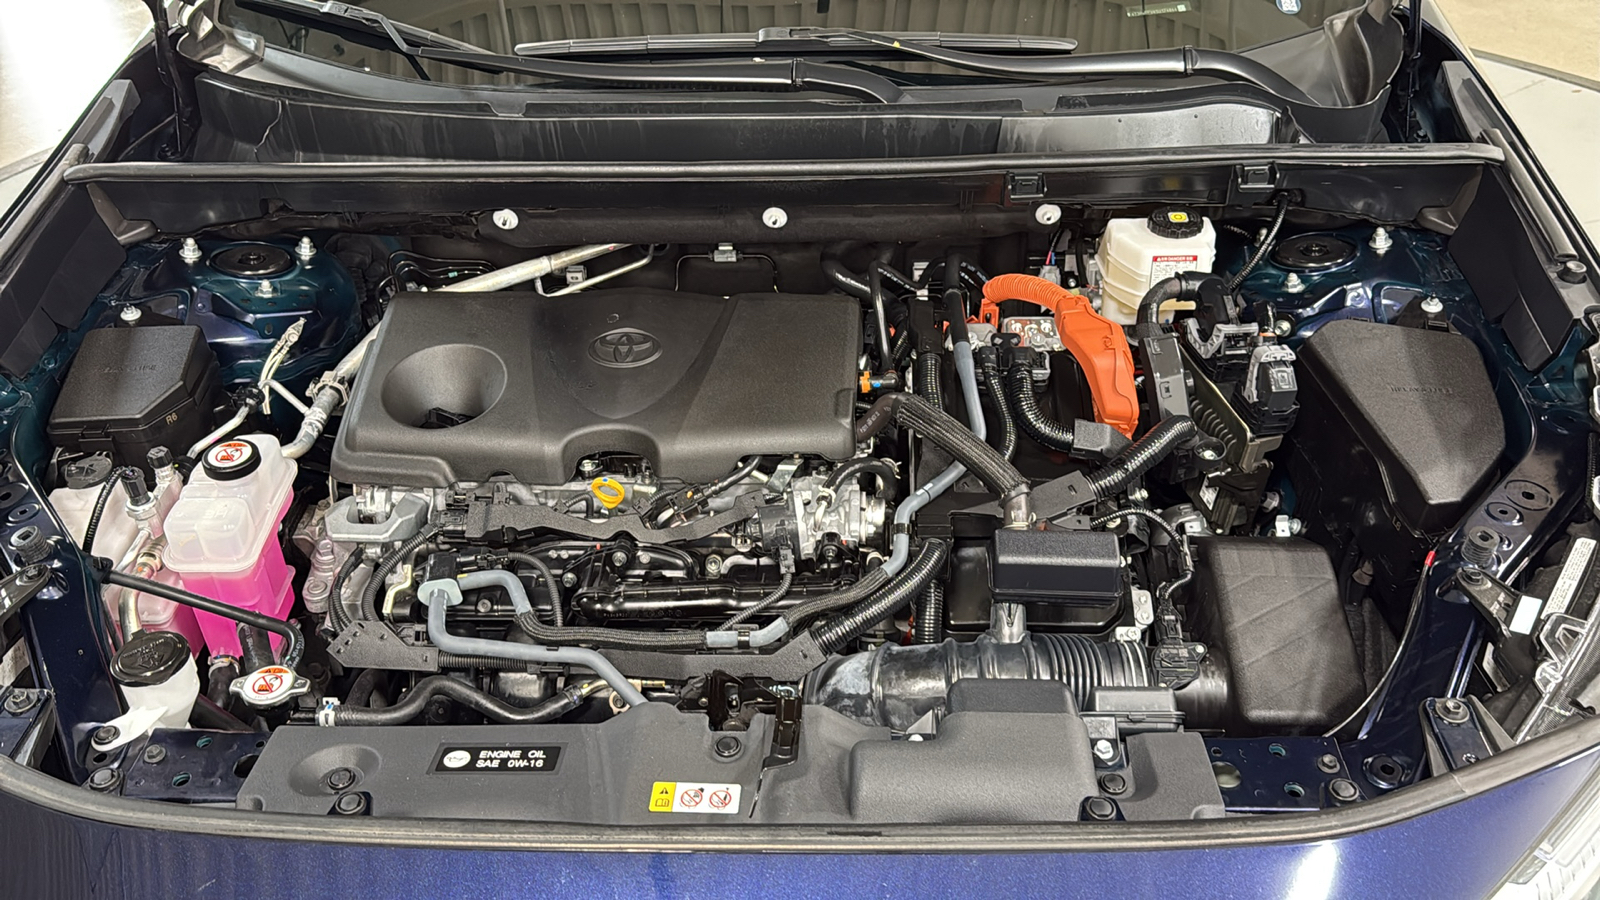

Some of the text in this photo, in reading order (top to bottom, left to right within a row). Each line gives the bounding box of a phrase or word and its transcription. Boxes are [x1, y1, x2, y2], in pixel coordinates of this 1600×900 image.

[165, 412, 178, 425] R6
[479, 750, 547, 759] ENGINE OIL
[475, 759, 544, 768] SAE 0W-16
